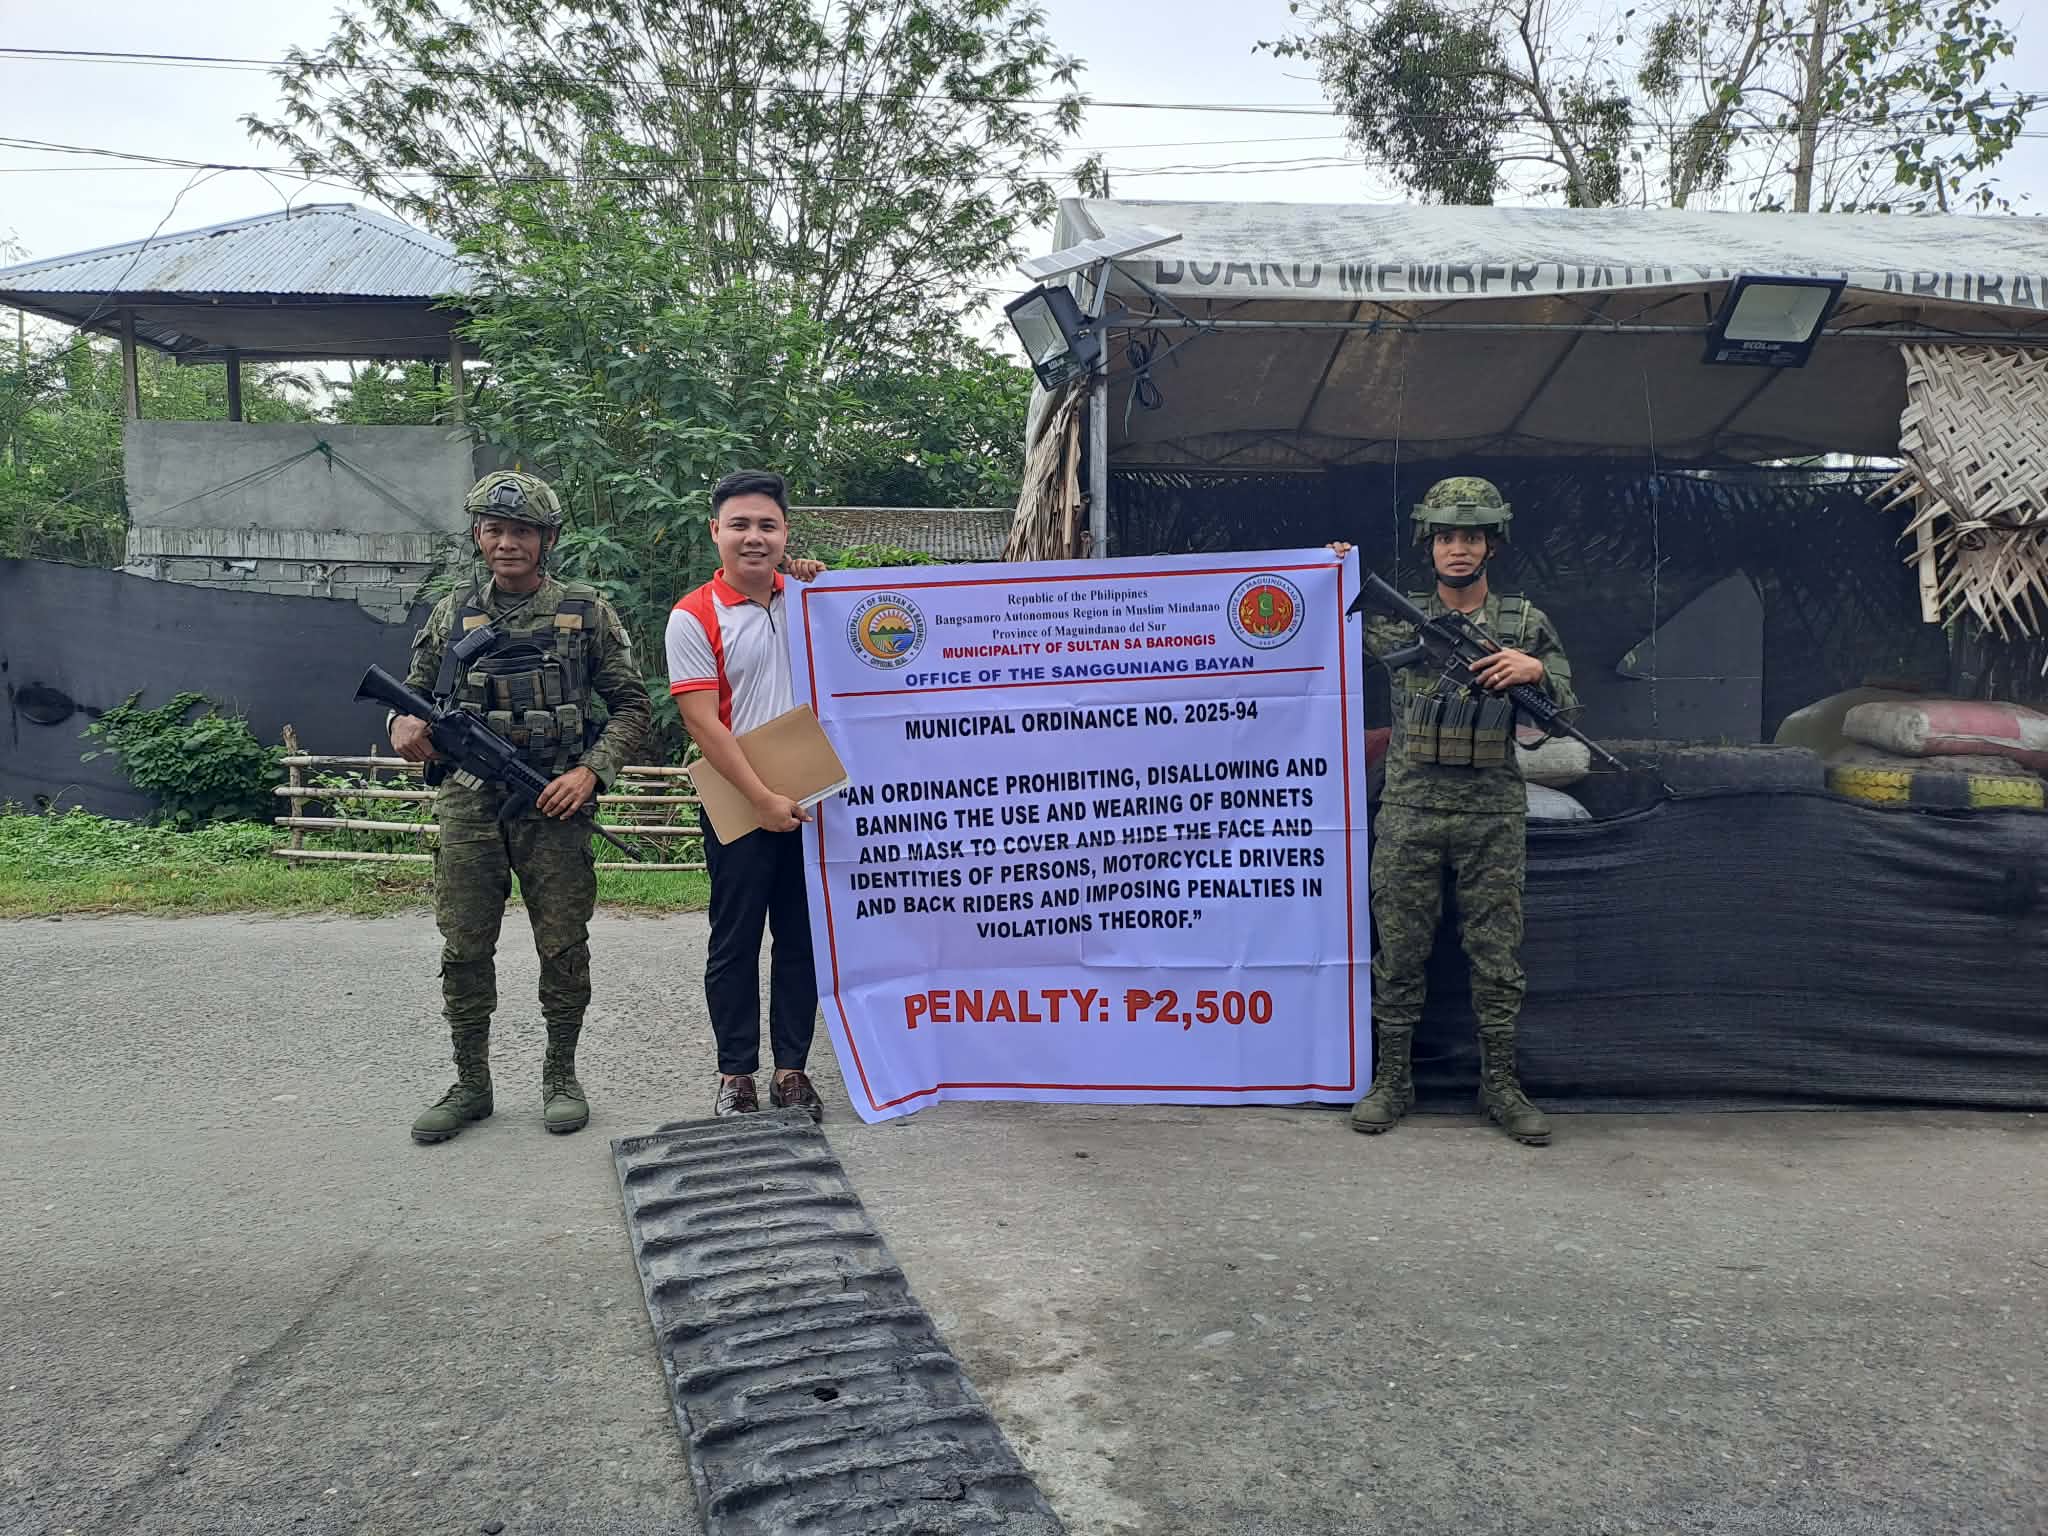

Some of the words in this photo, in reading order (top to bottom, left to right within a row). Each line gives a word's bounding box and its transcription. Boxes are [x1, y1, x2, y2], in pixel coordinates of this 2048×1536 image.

[935, 612, 1001, 627] Bangsamoro
[1003, 609, 1069, 622] Autonomous
[1073, 606, 1109, 621] Region
[1112, 606, 1122, 617] in
[1125, 603, 1165, 616] Muslim
[1168, 602, 1220, 615] Mindanao
[1007, 593, 1054, 607] Republic
[1056, 592, 1069, 603] of
[1070, 590, 1087, 602] the
[1090, 589, 1148, 604] Philippines
[943, 643, 1041, 659] MUNICIPALITY
[1045, 642, 1062, 654] OF
[1067, 639, 1120, 653] SULTAN
[1124, 638, 1142, 649] SA
[1146, 634, 1216, 649] BARONGIS
[992, 628, 1038, 641] Province
[1041, 626, 1053, 638] of
[1055, 624, 1126, 639] Maguindanao
[1129, 622, 1145, 634] del
[1148, 621, 1167, 633] Sur
[905, 670, 972, 687] OFFICE
[977, 669, 1002, 683] OF
[1007, 666, 1046, 681] THE
[1051, 660, 1189, 679] SANGGUNIANG
[1195, 655, 1255, 672] BAYAN
[905, 714, 1016, 741] MUNICIPAL
[1021, 707, 1139, 733] ORDINANCE
[1144, 705, 1178, 727] NO.
[1184, 700, 1259, 724] 2025-94
[881, 776, 999, 804] ORDINANCE
[1006, 767, 1141, 795] PROHIBITING,
[1147, 758, 1280, 786] DISALLOWING
[1286, 757, 1328, 778] AND
[855, 810, 948, 837] BANNING
[954, 807, 995, 830] THE
[1001, 804, 1041, 826] USE
[1046, 801, 1087, 824] AND
[1092, 794, 1184, 820] WEARING
[1189, 791, 1214, 812] OF
[1220, 787, 1314, 810] BONNETS
[858, 844, 901, 865] AND
[907, 839, 966, 862] MASK
[970, 837, 997, 857] TO
[1003, 832, 1070, 855] COVER
[1075, 829, 1116, 849] AND
[1121, 824, 1168, 846] HIDE
[1173, 821, 1212, 842] THE
[1217, 818, 1265, 839] FACE
[1271, 817, 1313, 838] AND
[850, 868, 962, 891] IDENTITIES
[968, 866, 994, 886] OF
[1000, 857, 1097, 884] PERSONS,
[1103, 848, 1233, 875] MOTORCYCLE
[1239, 847, 1325, 868] DRIVERS
[855, 897, 897, 920] AND
[903, 895, 957, 914] BACK
[962, 891, 1034, 914] RIDERS
[1039, 887, 1080, 909] AND
[1085, 879, 1181, 904] IMPOSING
[1187, 877, 1296, 899] PENALTIES
[1302, 877, 1323, 898] IN
[976, 913, 1093, 939] VIOLATIONS
[904, 988, 1109, 1030] PENALTY:
[1123, 988, 1273, 1031] ₱2,500
